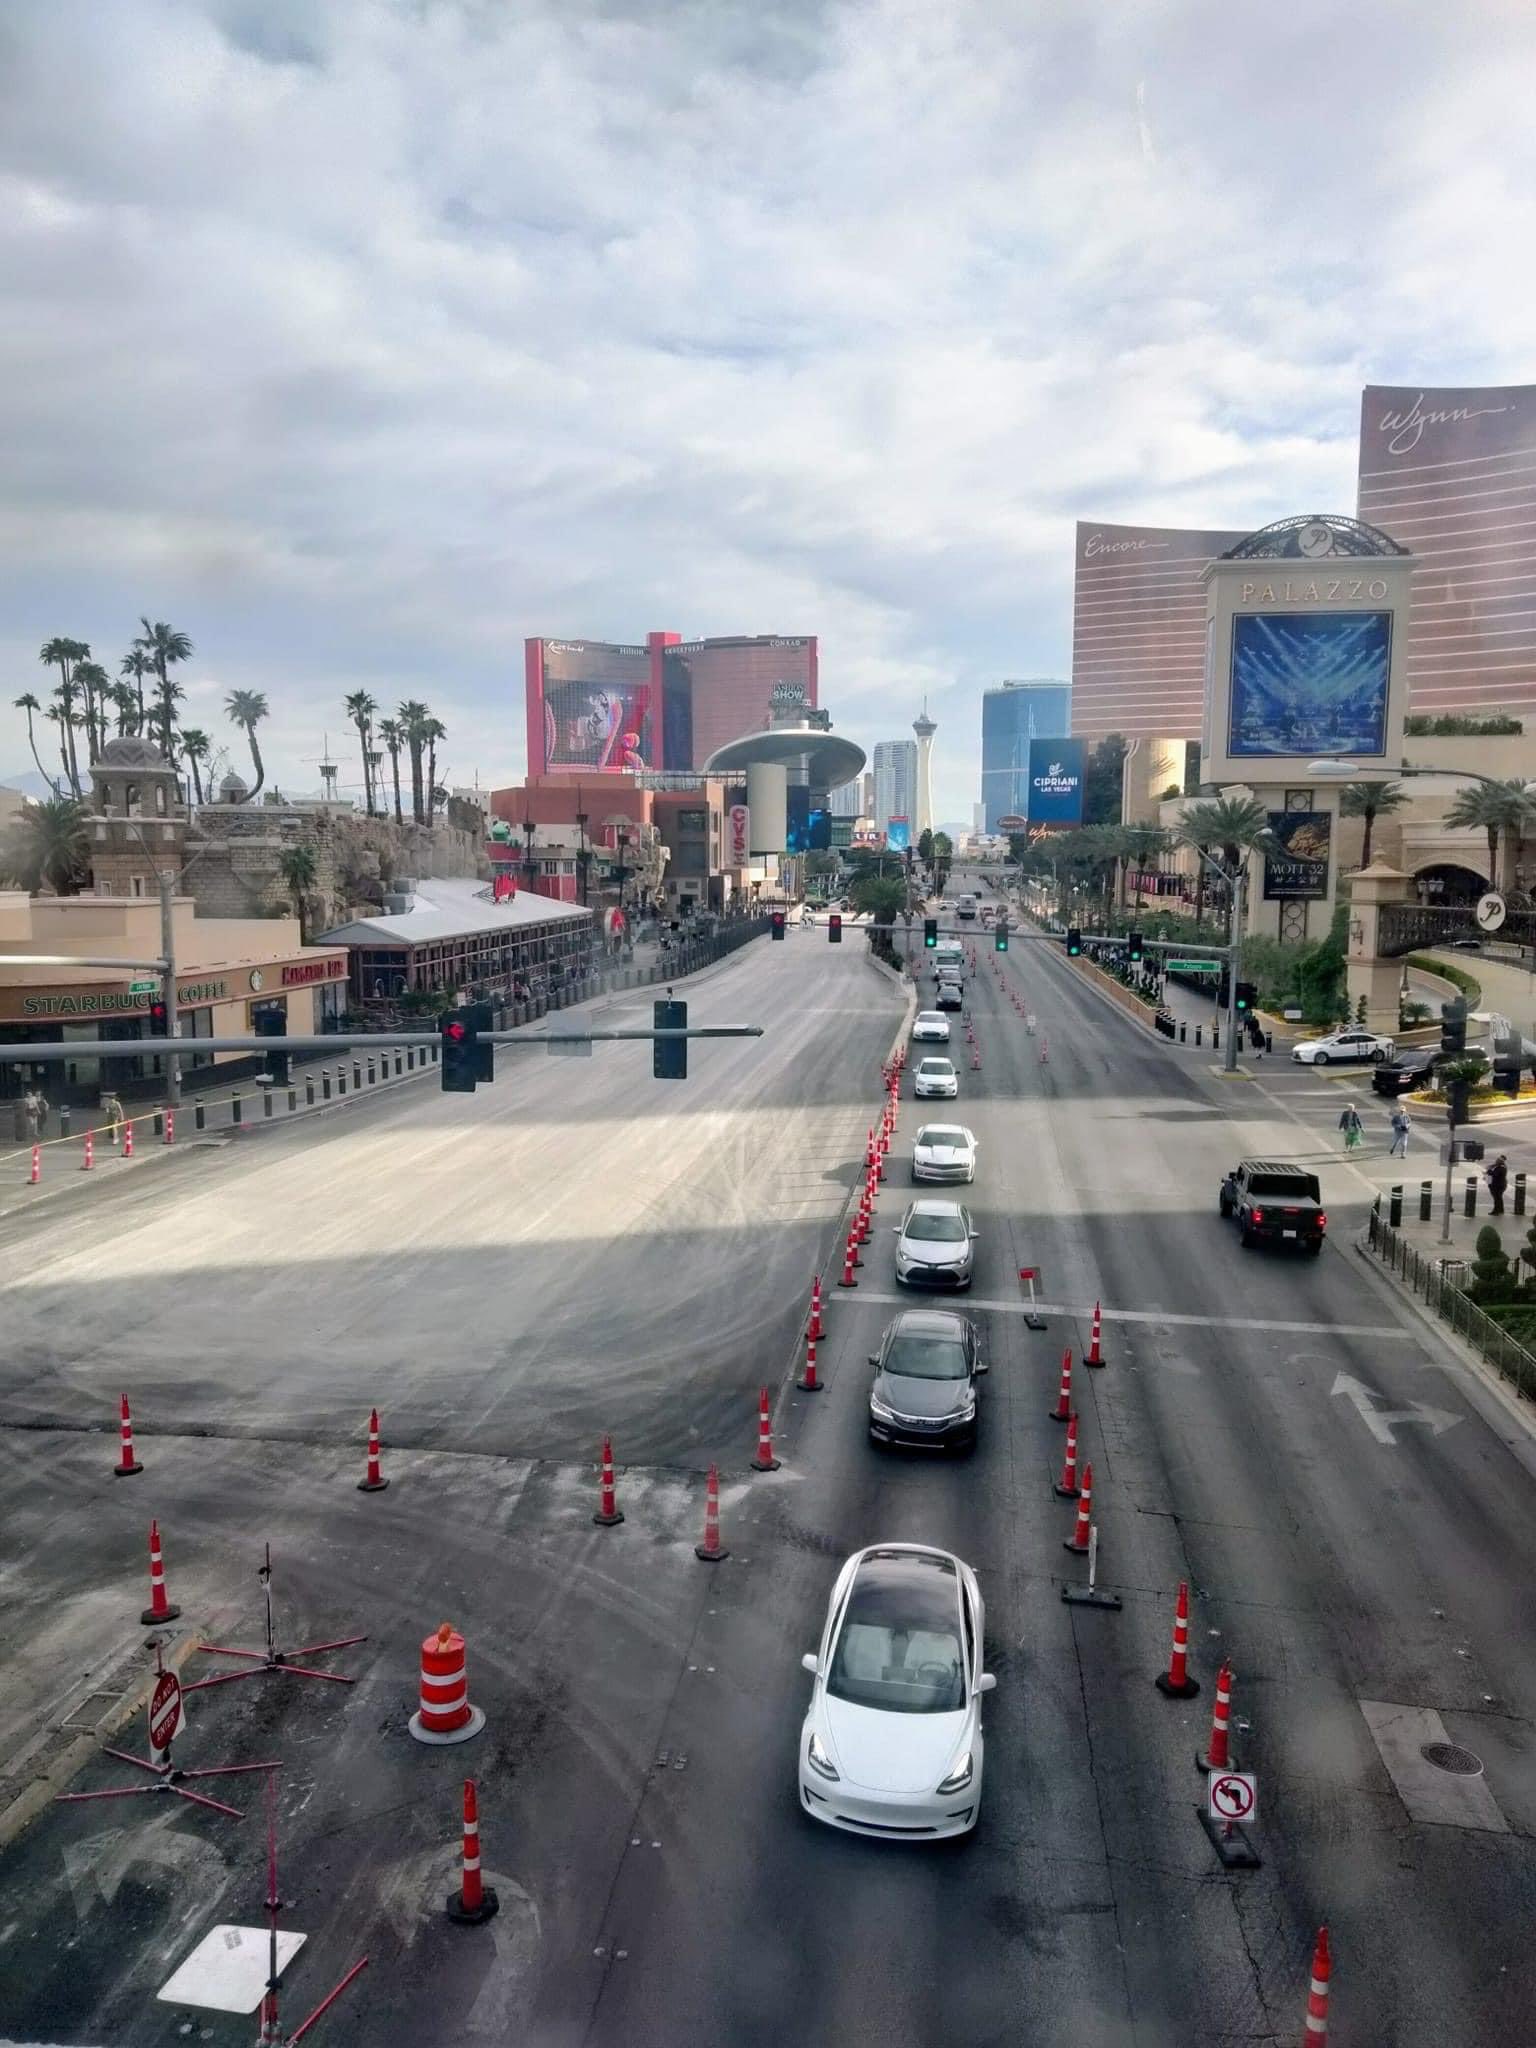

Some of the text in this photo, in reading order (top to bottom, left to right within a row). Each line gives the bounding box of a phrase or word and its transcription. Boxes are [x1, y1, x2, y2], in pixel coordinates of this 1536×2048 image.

[1084, 533, 1169, 557] Encore
[1241, 579, 1388, 603] PALAZZO
[773, 690, 804, 699] SHOW
[1034, 777, 1078, 787] CIPRIANI
[732, 808, 746, 851] CVS
[1271, 863, 1324, 875] MOTT 32
[23, 983, 226, 1015] STARBUCK COFFEE
[153, 1679, 175, 1713] DO NOT
[157, 1711, 175, 1741] ENTER
